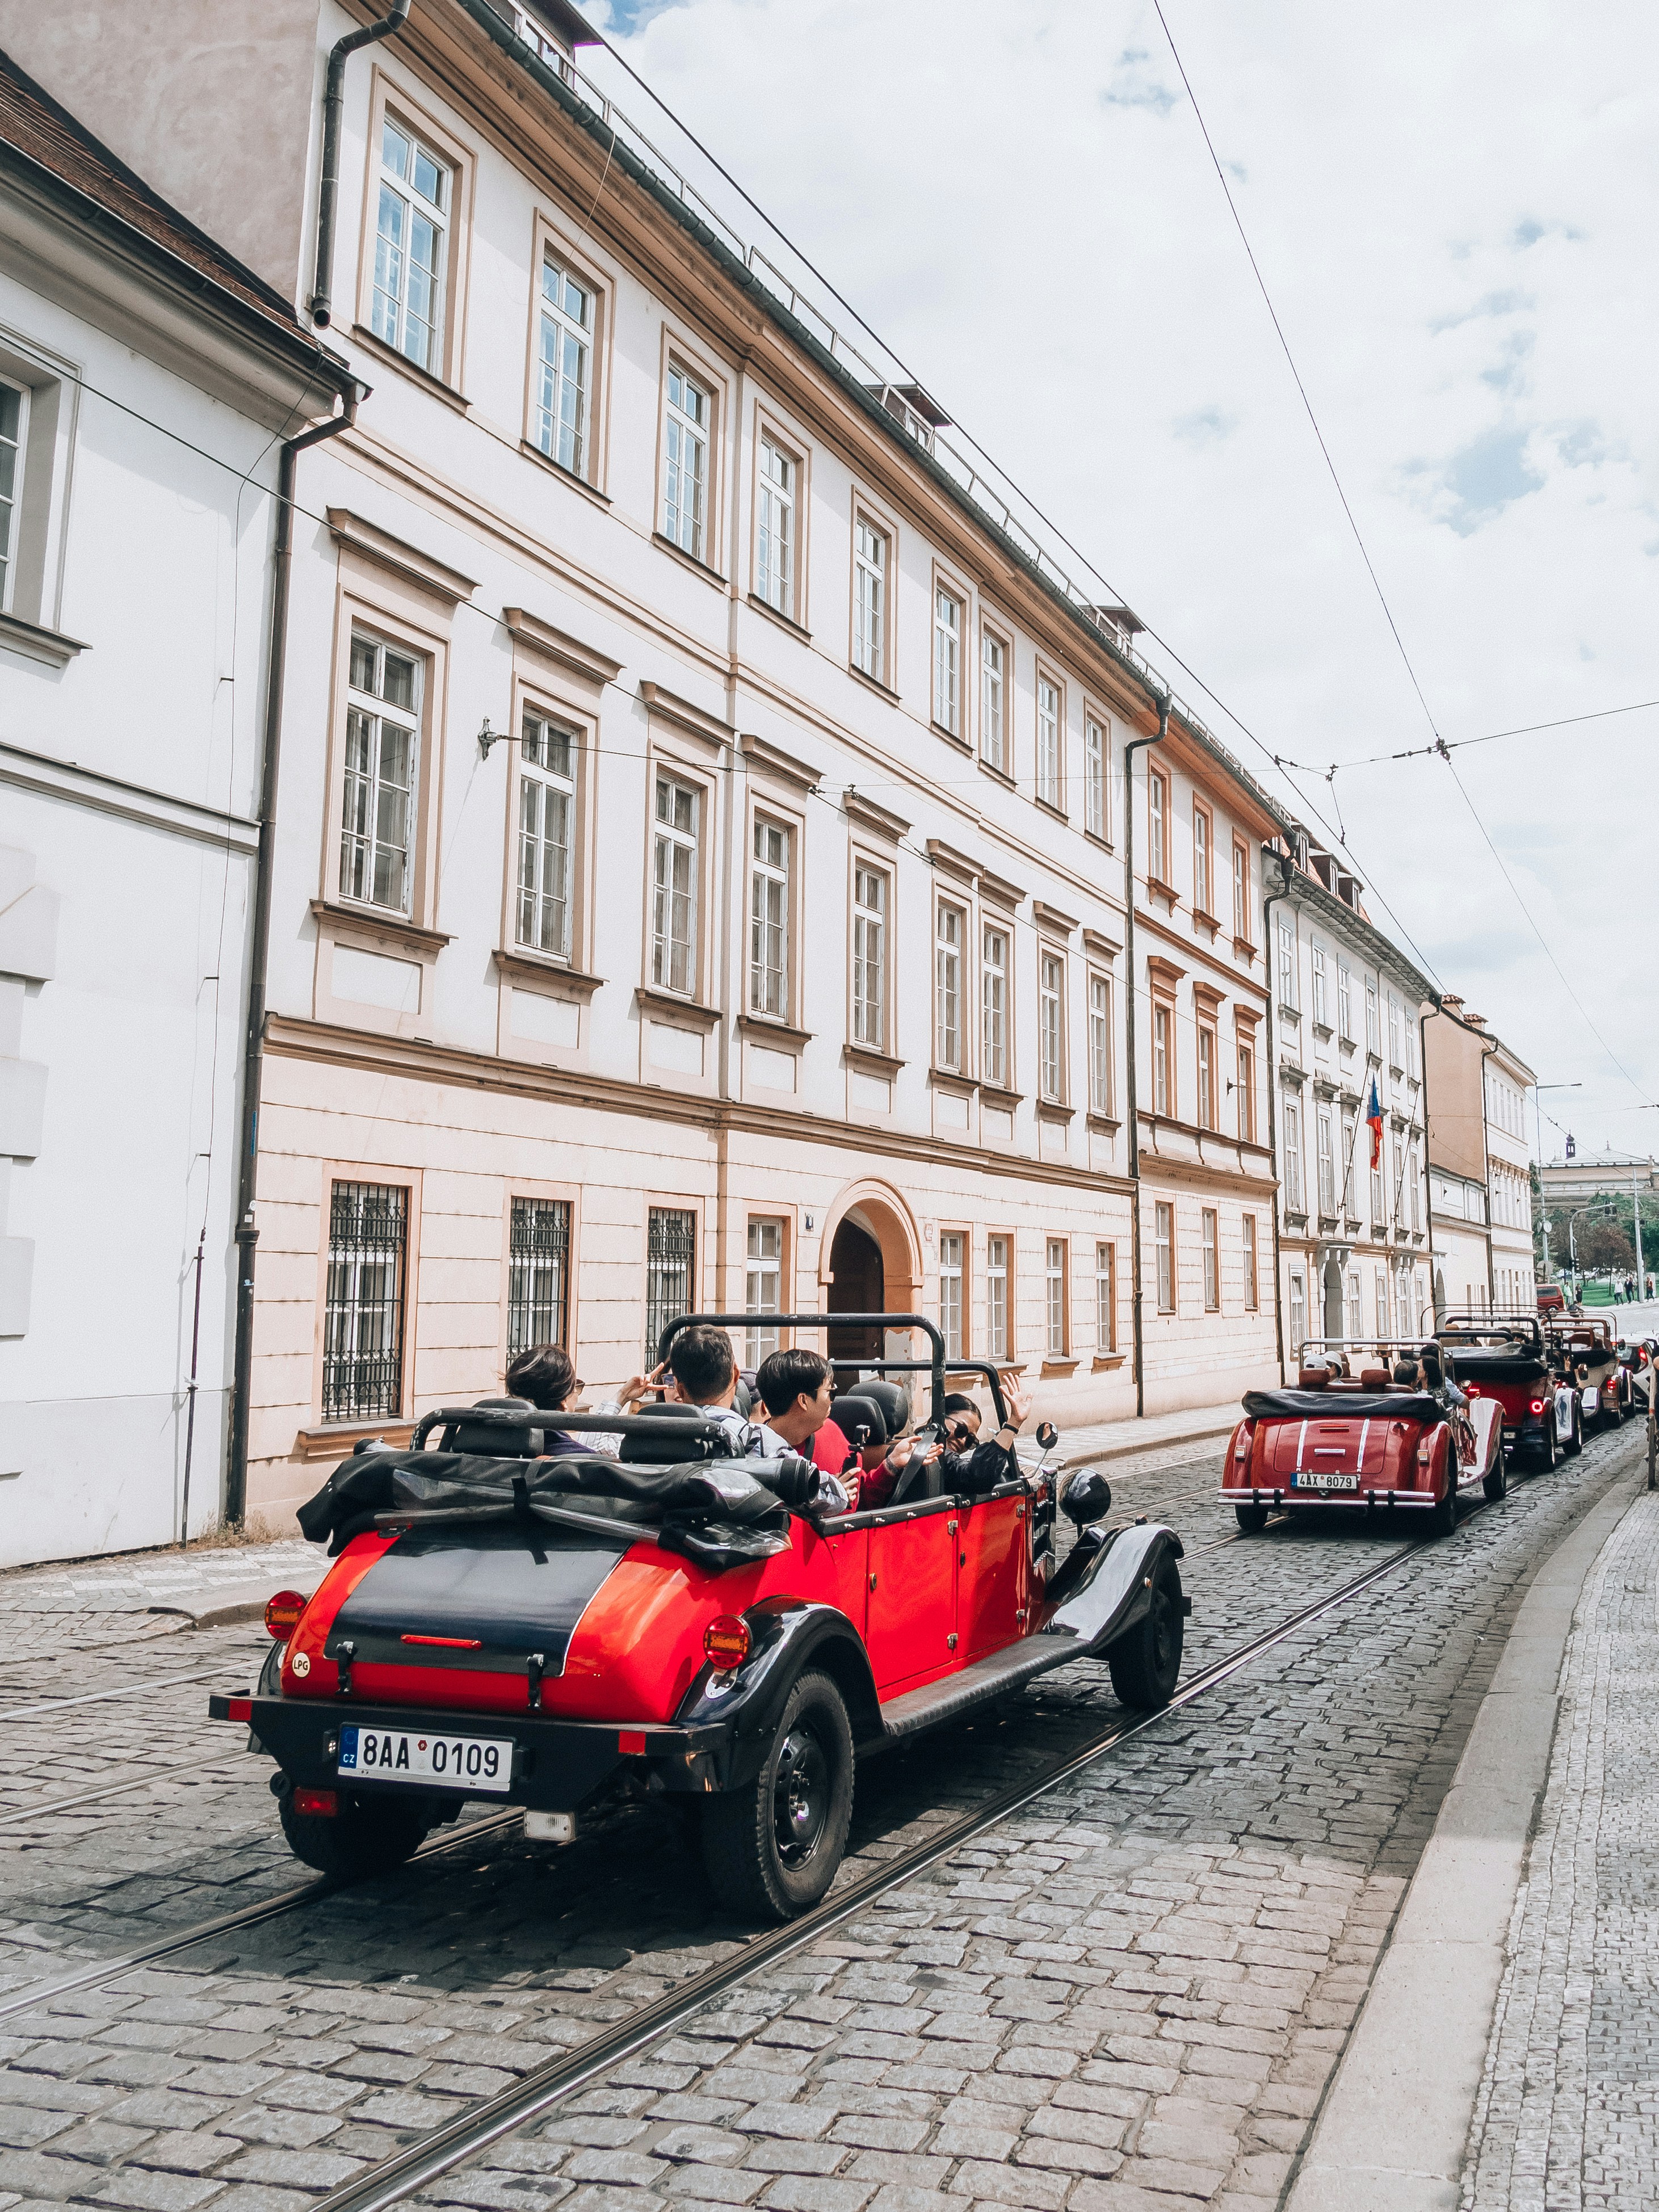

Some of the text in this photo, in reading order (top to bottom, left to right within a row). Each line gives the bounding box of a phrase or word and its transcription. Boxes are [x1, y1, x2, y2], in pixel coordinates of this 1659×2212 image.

[1300, 1475, 1352, 1488] 4AX 8079
[293, 1659, 308, 1671] LPG
[343, 1753, 355, 1764] CZ
[363, 1734, 499, 1778] 8AA 0109
